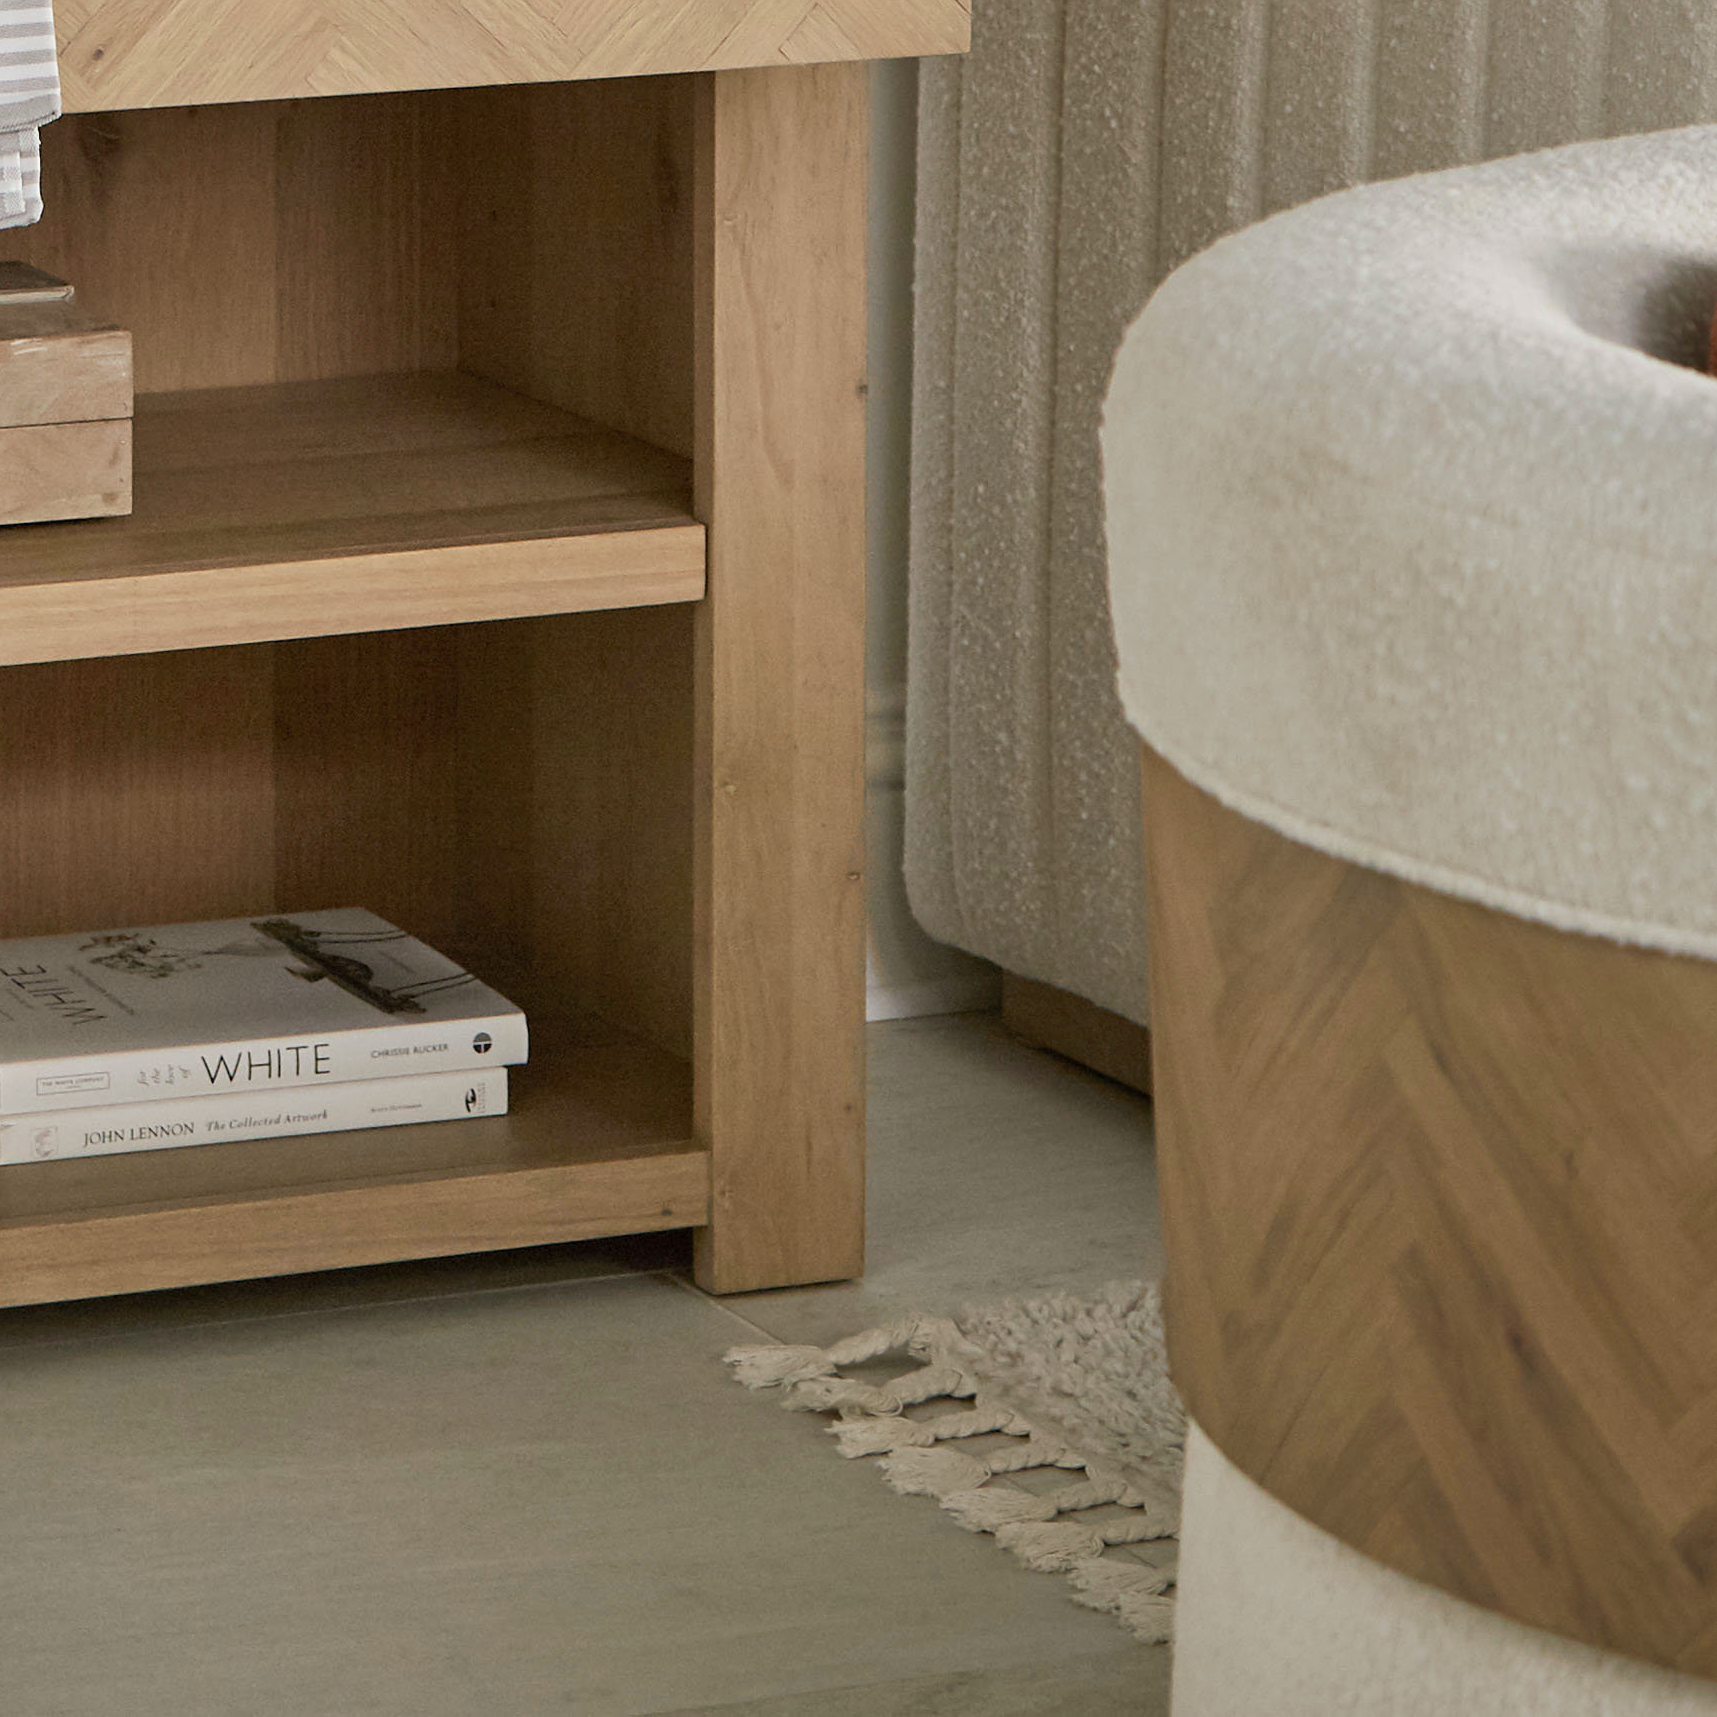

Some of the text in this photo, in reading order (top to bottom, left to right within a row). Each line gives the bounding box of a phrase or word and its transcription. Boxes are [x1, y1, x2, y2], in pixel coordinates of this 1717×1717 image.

[0, 964, 107, 1025] WHITE
[201, 1043, 331, 1084] WHITE
[83, 1121, 195, 1147] JOHN LENNON
[206, 1109, 328, 1132] The Collected Artwork
